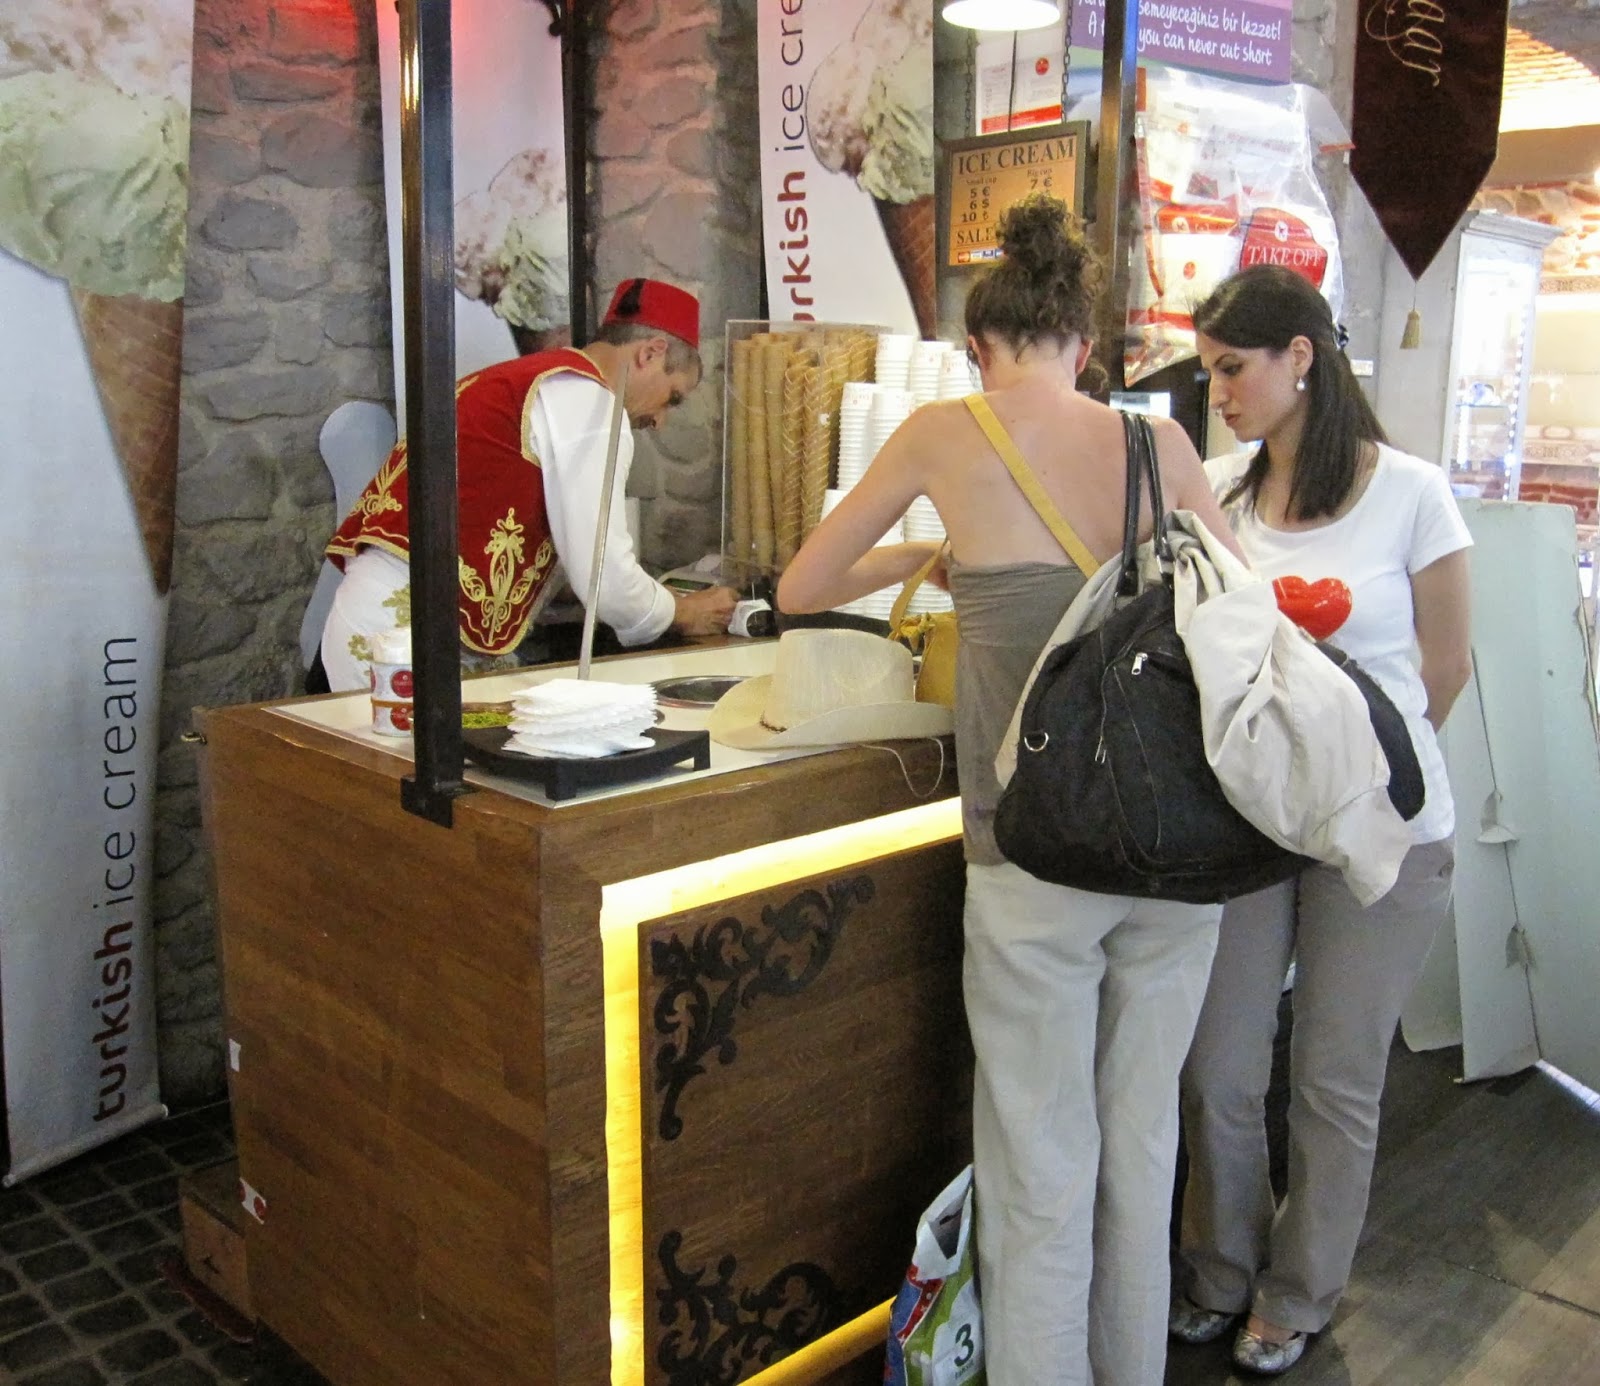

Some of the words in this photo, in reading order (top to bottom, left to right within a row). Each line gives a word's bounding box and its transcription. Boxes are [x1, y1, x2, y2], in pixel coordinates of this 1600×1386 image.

[781, 0, 803, 65] cre
[1088, 11, 1097, 37] A
[1136, 28, 1160, 52] you
[1163, 32, 1185, 50] can
[1188, 37, 1217, 55] never
[1220, 42, 1240, 60] cut
[1242, 40, 1272, 66] short
[1138, 1, 1219, 33] semeyeceğiniz
[1223, 7, 1238, 32] bir
[1241, 11, 1281, 40] lezzet!
[775, 84, 804, 151] ice
[958, 152, 991, 175] ICE
[998, 138, 1074, 168] CREAM
[970, 188, 977, 198] 5
[970, 201, 977, 210] 6
[1030, 179, 1038, 190] 7
[962, 212, 976, 222] 10
[777, 171, 815, 321] rkish
[1248, 245, 1291, 265] TAKE
[1293, 248, 1324, 266] OFF
[104, 637, 137, 810] cream
[93, 832, 135, 908] ice
[92, 921, 133, 1122] turkish
[954, 1323, 974, 1367] 3
